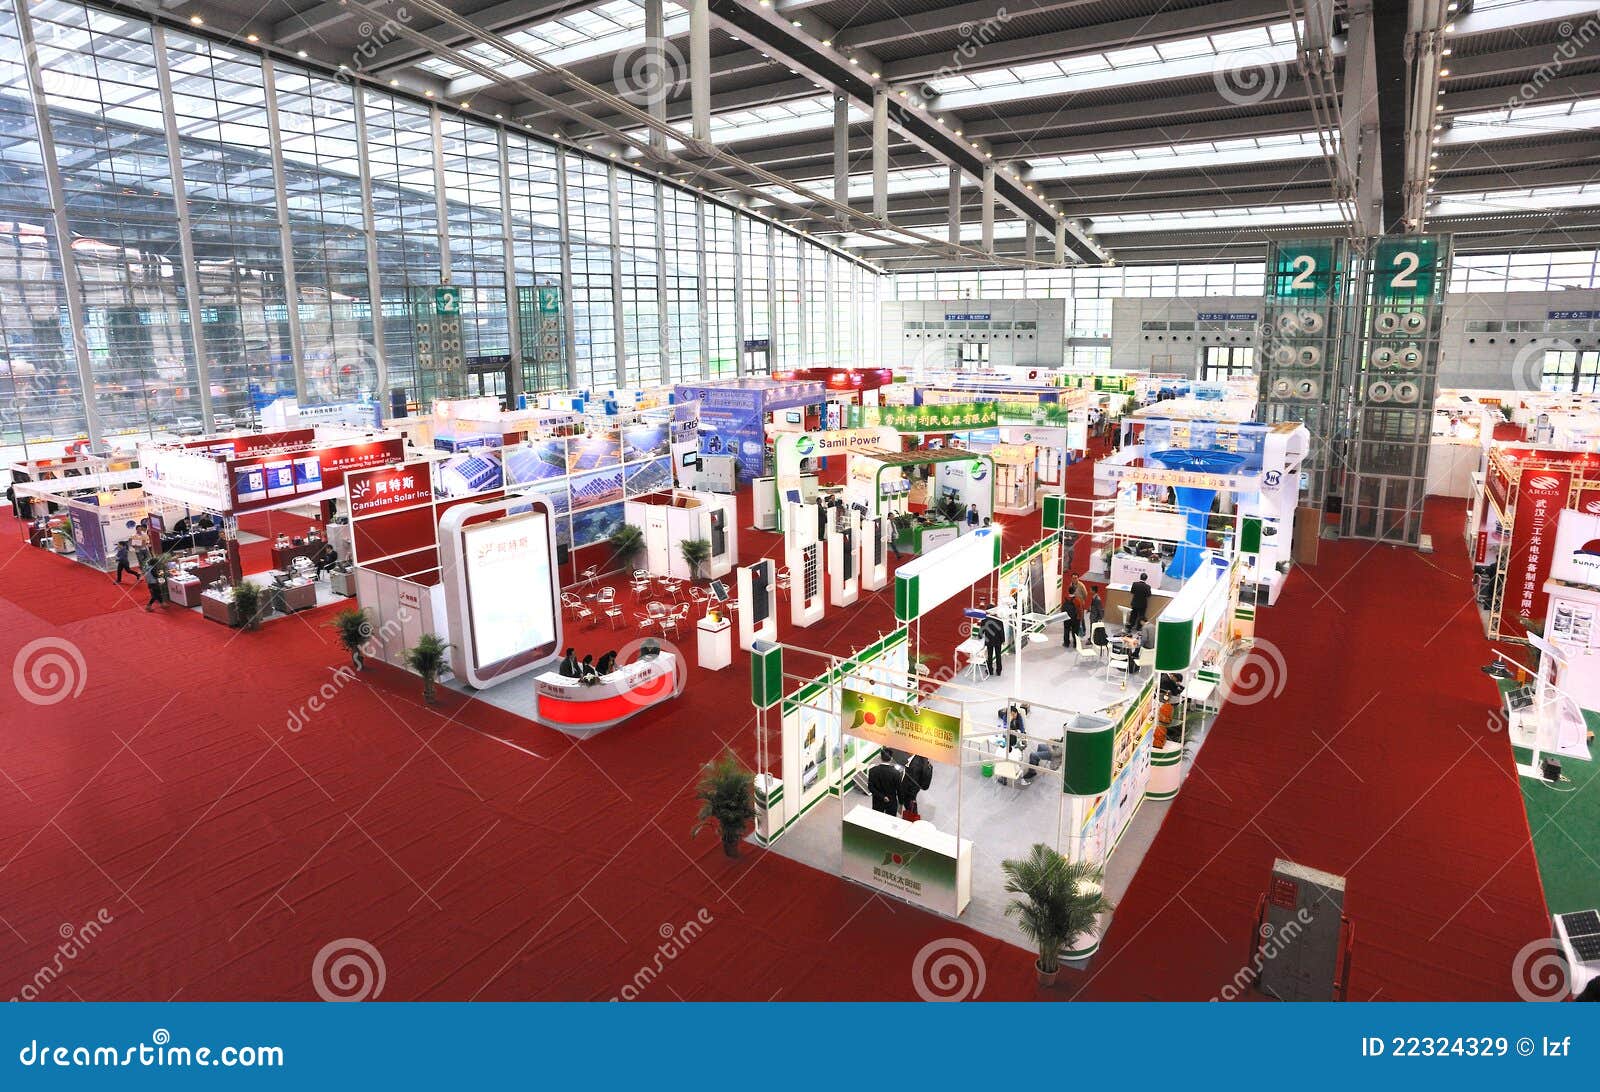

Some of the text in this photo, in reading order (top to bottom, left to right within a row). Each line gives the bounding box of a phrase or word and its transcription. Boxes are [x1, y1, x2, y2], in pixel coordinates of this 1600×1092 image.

[1291, 255, 1316, 289] 2
[1390, 251, 1420, 288] 2
[443, 293, 453, 311] 2
[545, 293, 555, 309] 2
[819, 435, 881, 449] Samil Power
[375, 476, 414, 494] 阿特斯
[1528, 488, 1560, 497] ARGUS
[352, 496, 393, 511] Canadian
[394, 492, 415, 503] Solar
